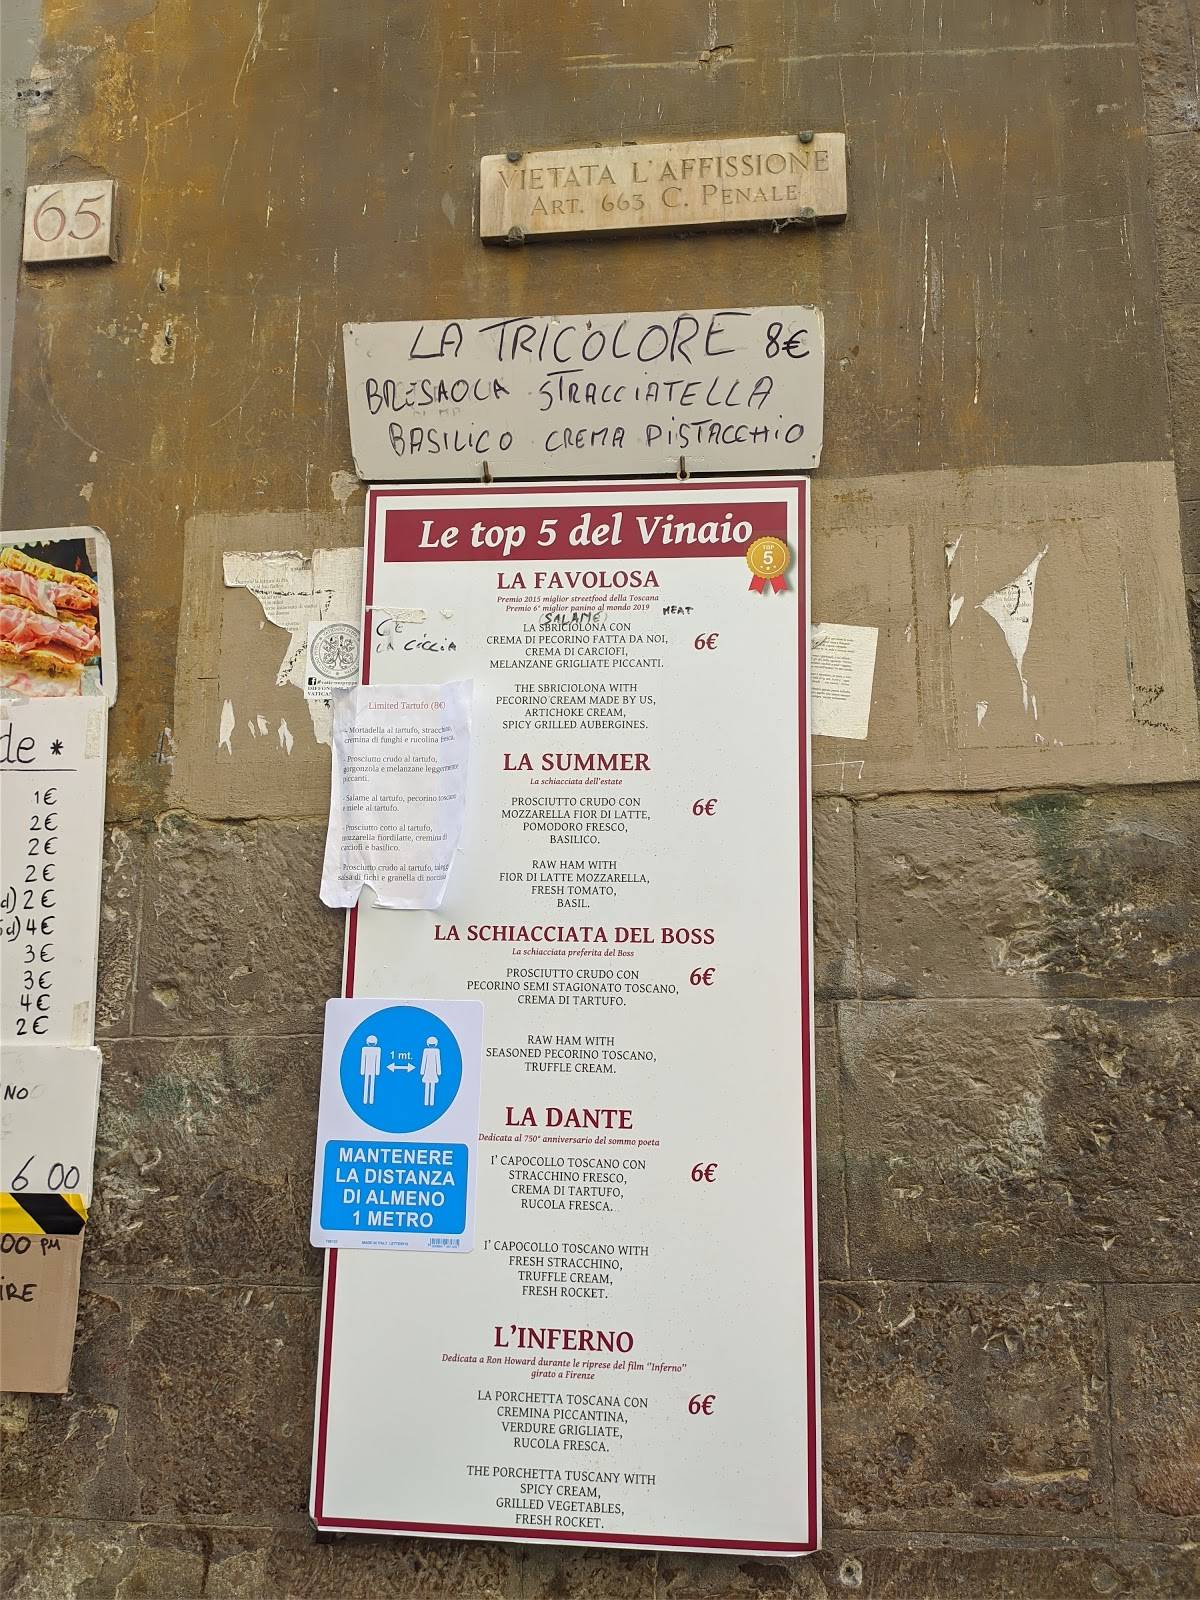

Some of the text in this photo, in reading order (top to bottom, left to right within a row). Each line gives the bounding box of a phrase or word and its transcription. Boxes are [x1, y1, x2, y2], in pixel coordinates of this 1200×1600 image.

[498, 150, 829, 192] VIETATA L'AFFISSIONE
[601, 194, 644, 213] 663
[662, 187, 689, 208] C.
[34, 190, 104, 242] 65
[410, 313, 810, 365] LA TRICOLORE 8€
[539, 370, 773, 411] STRACCIATELLA
[546, 428, 624, 452] CREMA
[419, 512, 753, 557] Le top 5 del Vinaio
[763, 550, 773, 564] 5
[497, 570, 660, 589] LA FAVOLOSA
[543, 595, 568, 603] miglior
[571, 594, 608, 602] streetfood
[542, 605, 568, 613] miglior
[523, 623, 631, 632] LA SBRICIOLONA CON
[486, 635, 668, 645] CREMA DI PECORINO FATTA DA NOI,
[694, 633, 719, 651] 6€
[368, 702, 398, 710] Limited
[400, 701, 430, 710] Tartufo
[503, 753, 651, 771] LA SUMMER
[530, 777, 622, 785] La schiacciata dell'estate
[511, 797, 641, 807] PROSCIUTTO CRUDO CON
[692, 798, 718, 816] 6€
[501, 810, 651, 820] MOZZARELLA FIOR DI LATTE,
[434, 924, 715, 944] LA SCHIACCIATA DEL BOSS
[523, 948, 566, 956] schiacciata
[568, 948, 601, 957] preferita
[604, 949, 615, 957] del
[506, 968, 639, 980] PROSCIUTTO CRUDO CON
[689, 968, 716, 986] 6€
[467, 980, 679, 996] PECORINO SEMI STAGIONATO TOSCANO,
[390, 1051, 414, 1060] 1 mt.
[505, 1106, 633, 1130] LA DANTE
[478, 1133, 513, 1142] Dedicata
[515, 1134, 522, 1142] al
[542, 1136, 593, 1144] anniversario
[594, 1137, 607, 1145] del
[638, 1139, 660, 1148] poeta
[339, 1147, 453, 1165] MANTENERE
[500, 1156, 565, 1167] CAPOCOLLO
[567, 1158, 620, 1169] TOSCANO
[622, 1160, 646, 1170] CON
[336, 1168, 455, 1186] LA DISTANZA
[691, 1163, 718, 1182] 6€
[343, 1189, 445, 1207] DI ALMENO
[353, 1211, 433, 1228] 1 METRO
[494, 1325, 634, 1353] L'INFERNO
[442, 1354, 477, 1364] Dedicata
[486, 1356, 502, 1365] Ron
[504, 1356, 536, 1366] Howard
[538, 1358, 571, 1367] durante
[573, 1359, 580, 1368] le
[582, 1360, 611, 1371] riprese
[613, 1360, 625, 1370] del
[627, 1361, 644, 1372] film
[531, 1370, 556, 1380] girato
[565, 1370, 595, 1380] Firenze
[478, 1390, 648, 1408] LA PORCHETTA TOSCANA CON
[688, 1394, 716, 1415] 6€
